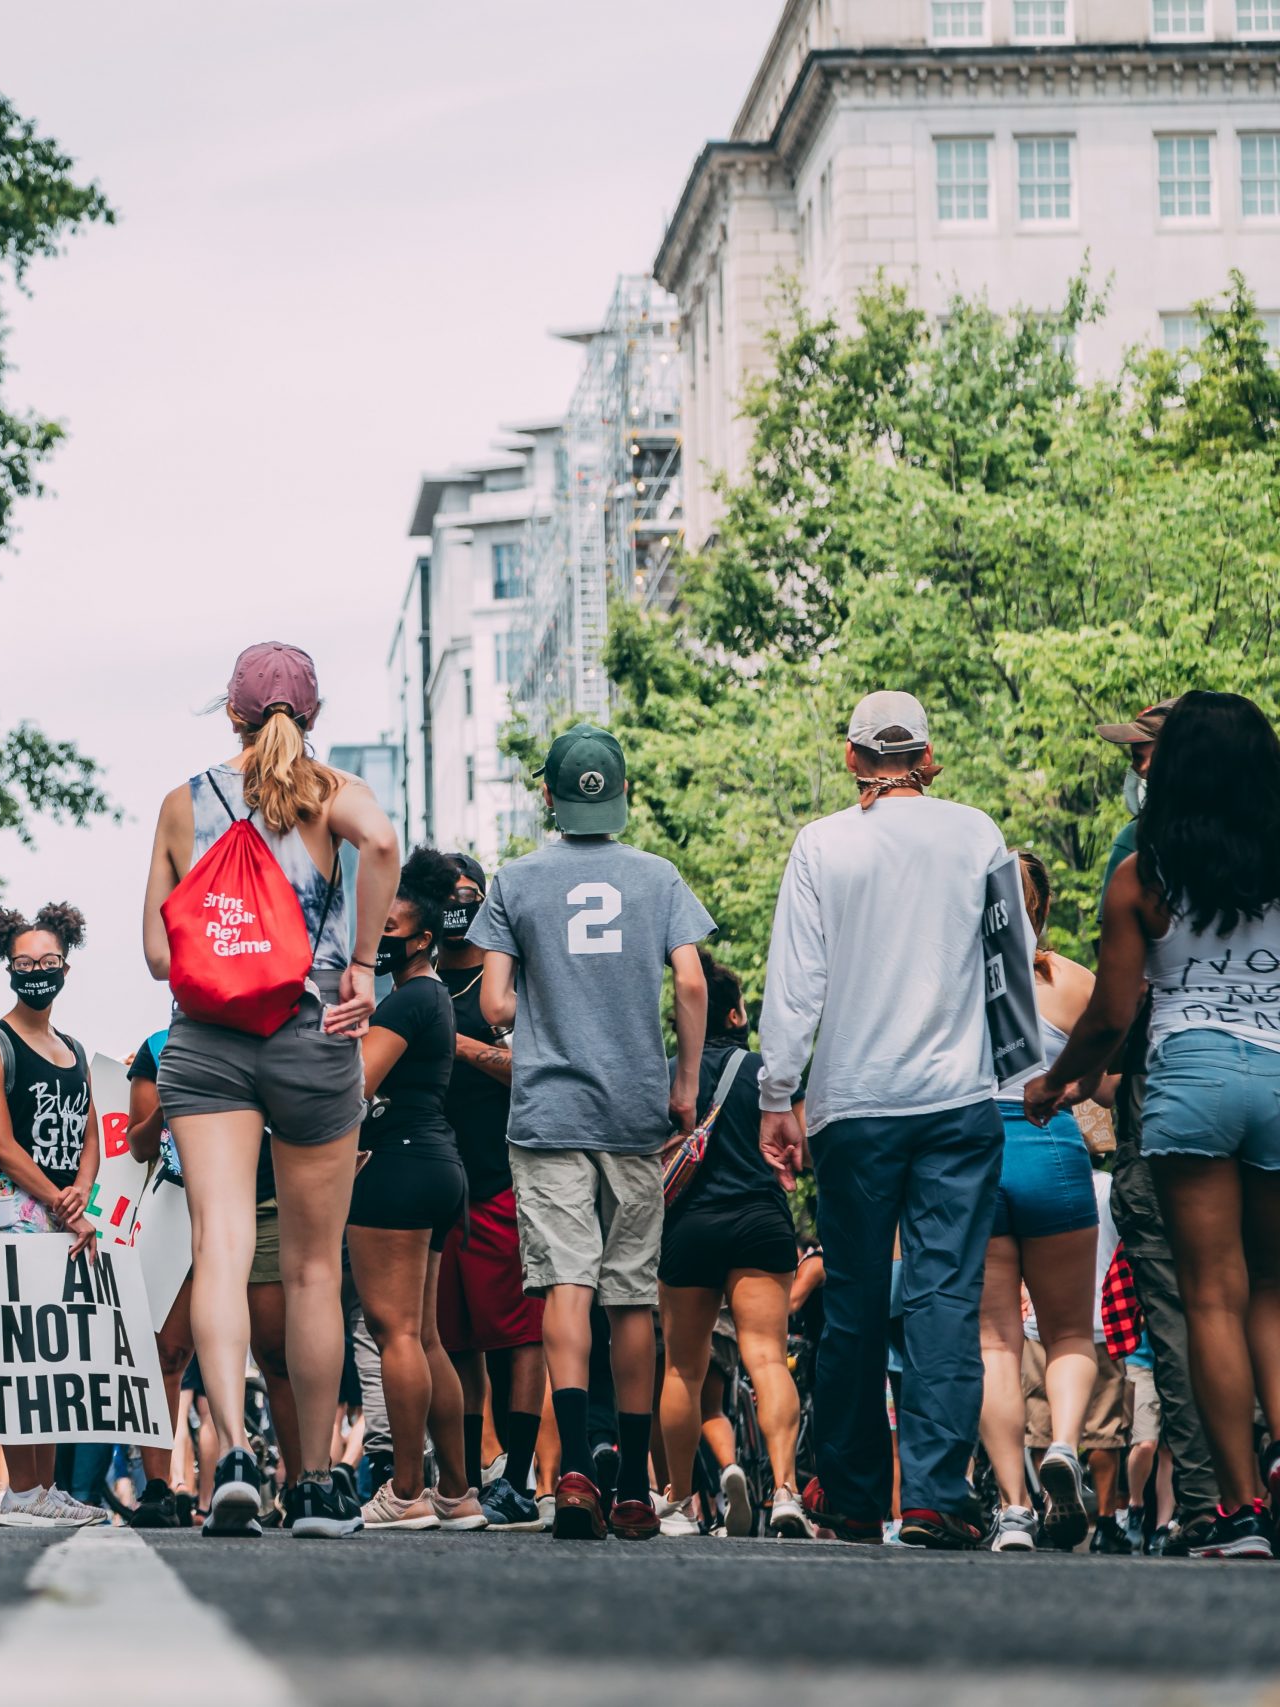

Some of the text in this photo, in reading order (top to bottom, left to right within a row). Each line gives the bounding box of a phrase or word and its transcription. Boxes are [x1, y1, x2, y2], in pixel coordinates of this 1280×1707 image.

[213, 940, 272, 957] Game
[566, 882, 622, 954] 2
[983, 899, 1009, 938] IVES
[5, 1244, 121, 1308] I AM
[1, 1303, 135, 1367] NOT A
